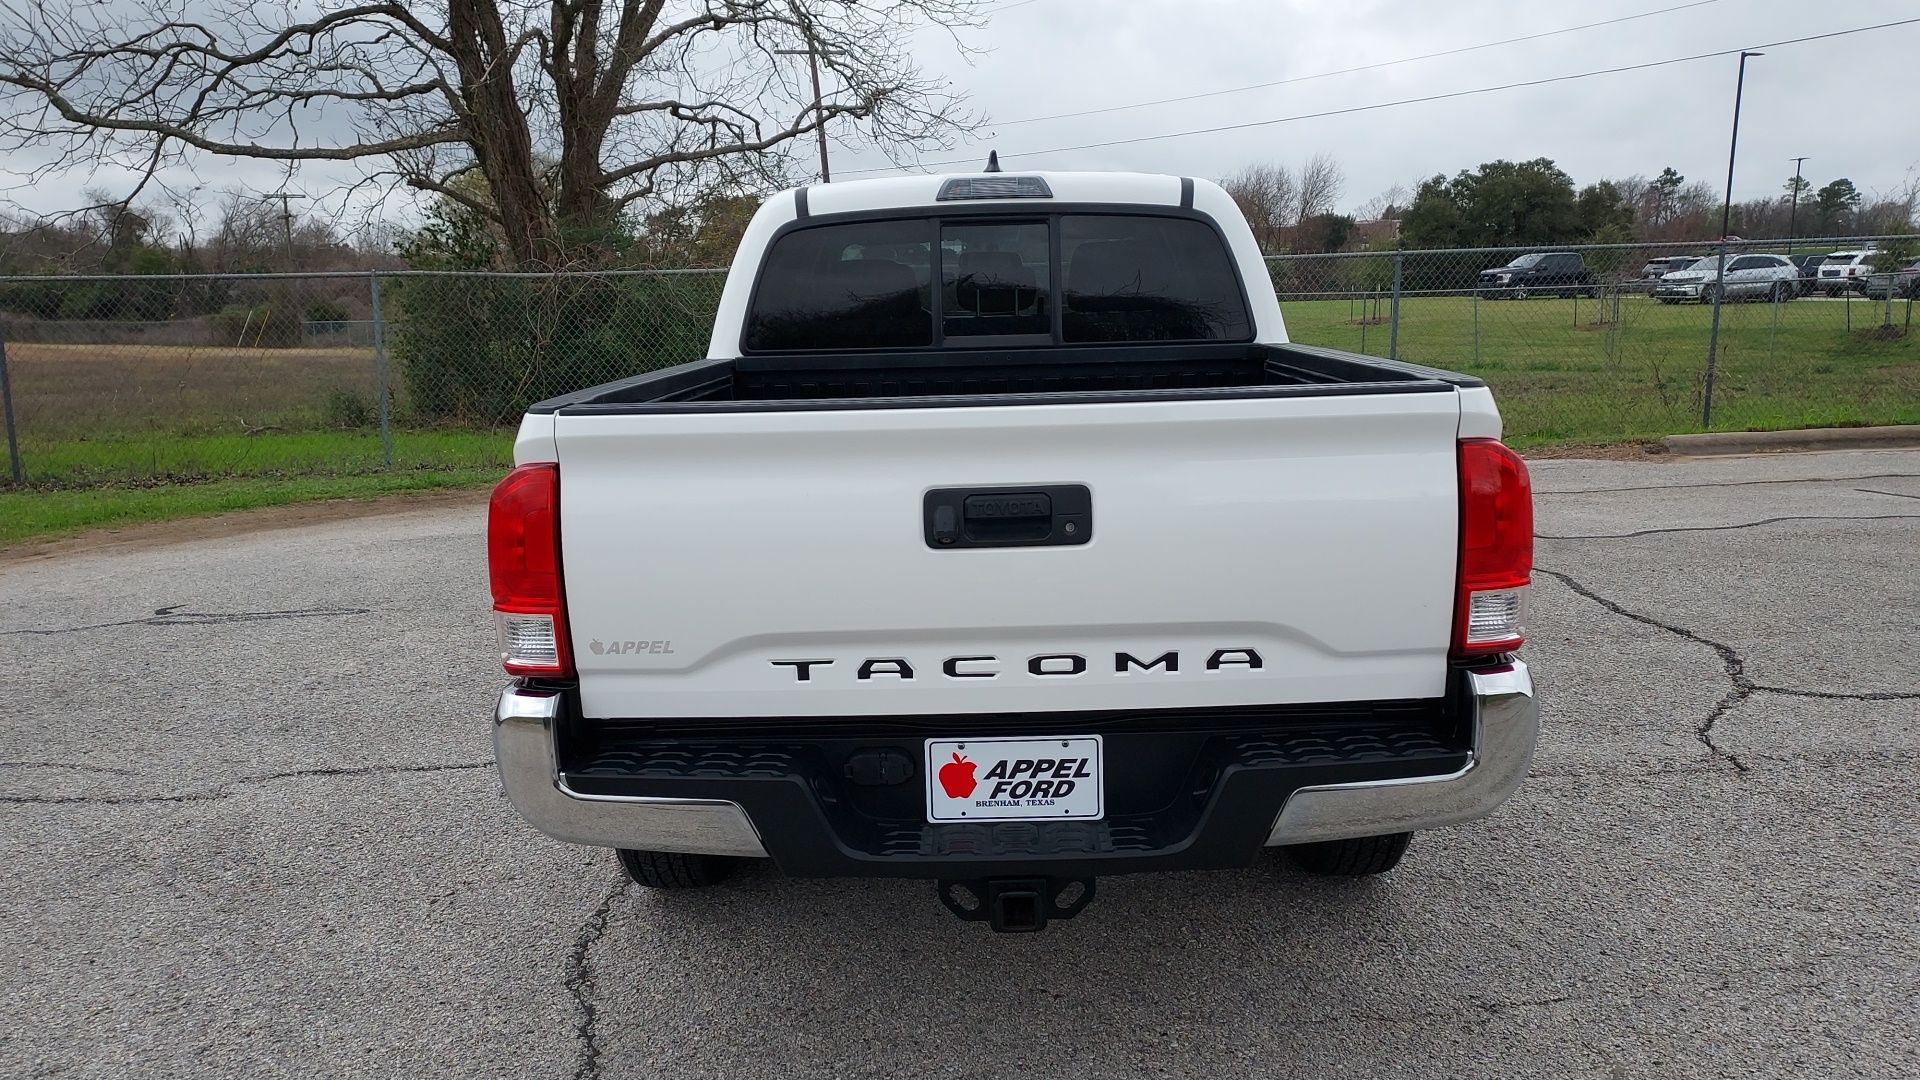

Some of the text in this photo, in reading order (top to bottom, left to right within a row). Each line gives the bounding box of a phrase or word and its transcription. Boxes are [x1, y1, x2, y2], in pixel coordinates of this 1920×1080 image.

[972, 500, 1045, 516] TOYOTA
[605, 641, 674, 654] APPEL
[769, 648, 1265, 683] TACOMA
[983, 758, 1091, 780] APPEL
[988, 780, 1076, 799] FORD
[975, 799, 1056, 808] BRENHAM, TEXAS
